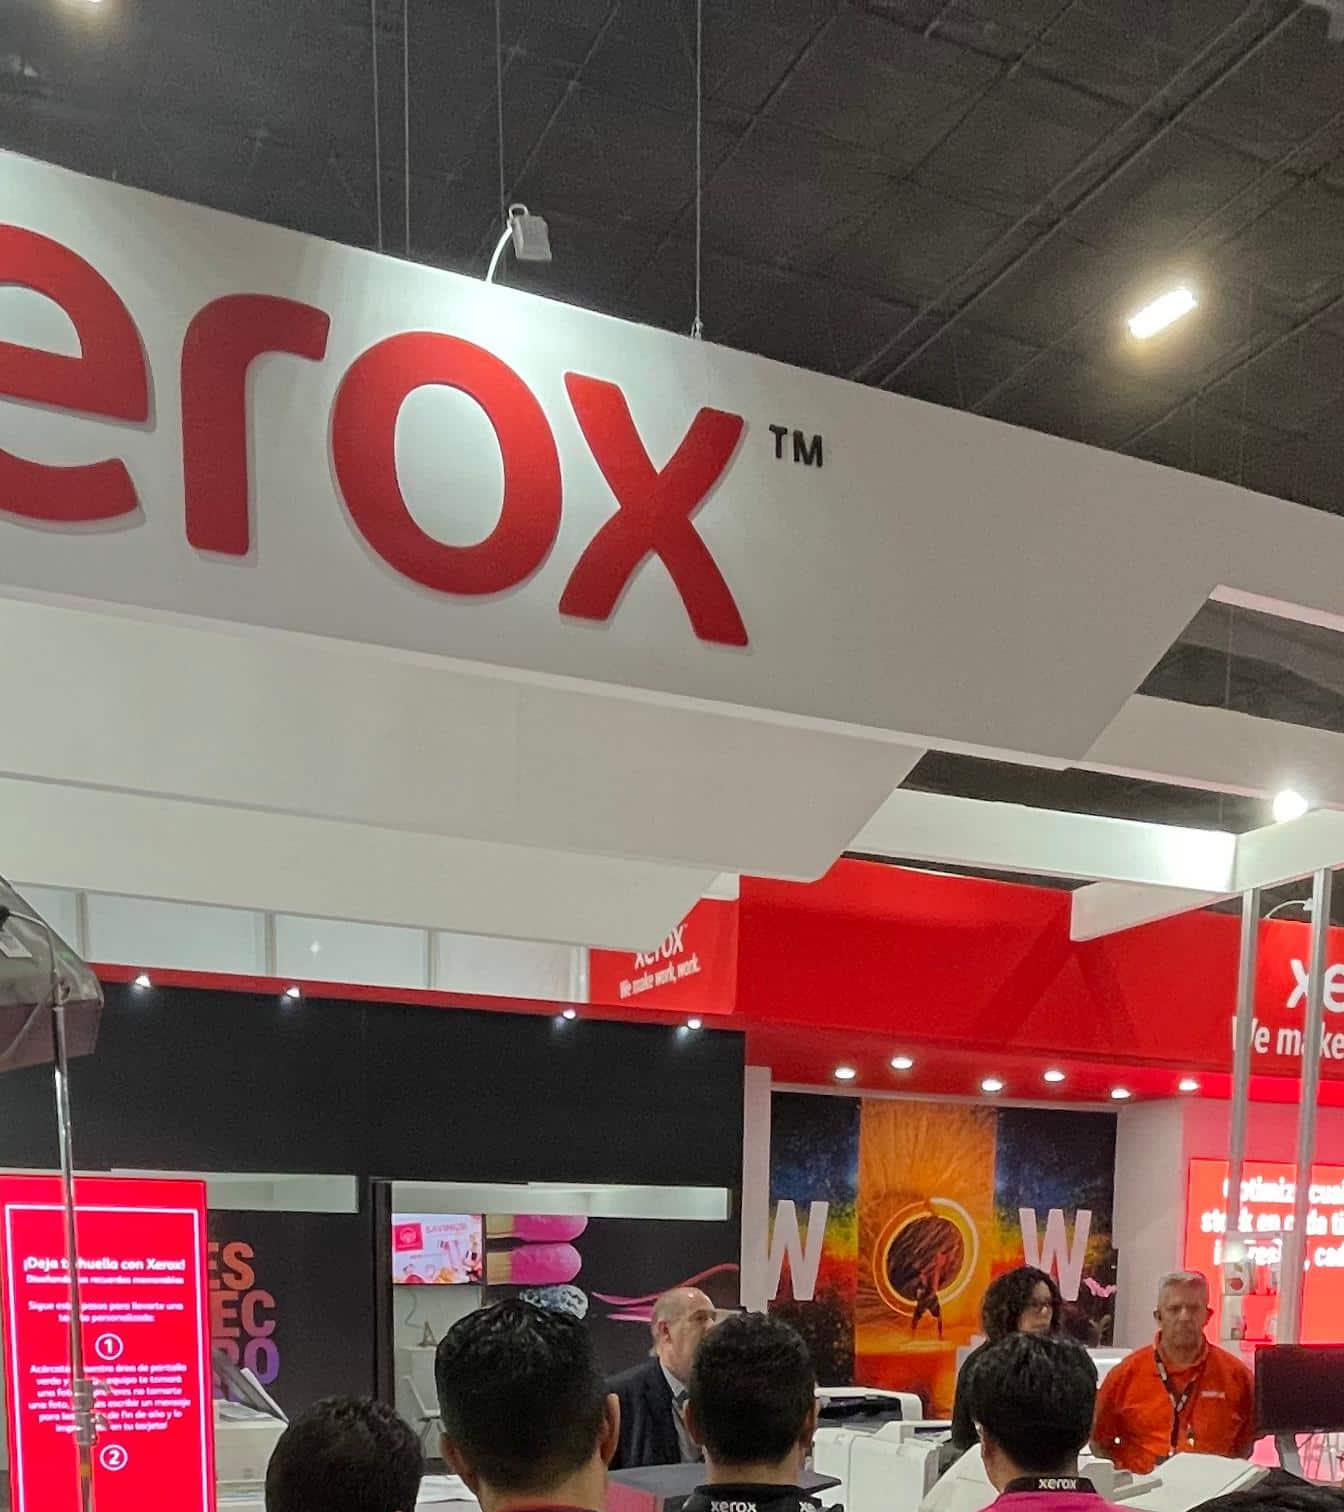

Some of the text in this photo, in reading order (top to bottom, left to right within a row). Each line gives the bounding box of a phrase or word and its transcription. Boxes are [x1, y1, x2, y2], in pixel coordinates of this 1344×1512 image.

[1283, 1209, 1328, 1236] cda
[79, 1257, 118, 1270] huella
[120, 1259, 144, 1270] con
[146, 1259, 186, 1271] Xerox!
[210, 1290, 276, 1338] EC
[1038, 1478, 1077, 1490] xerox
